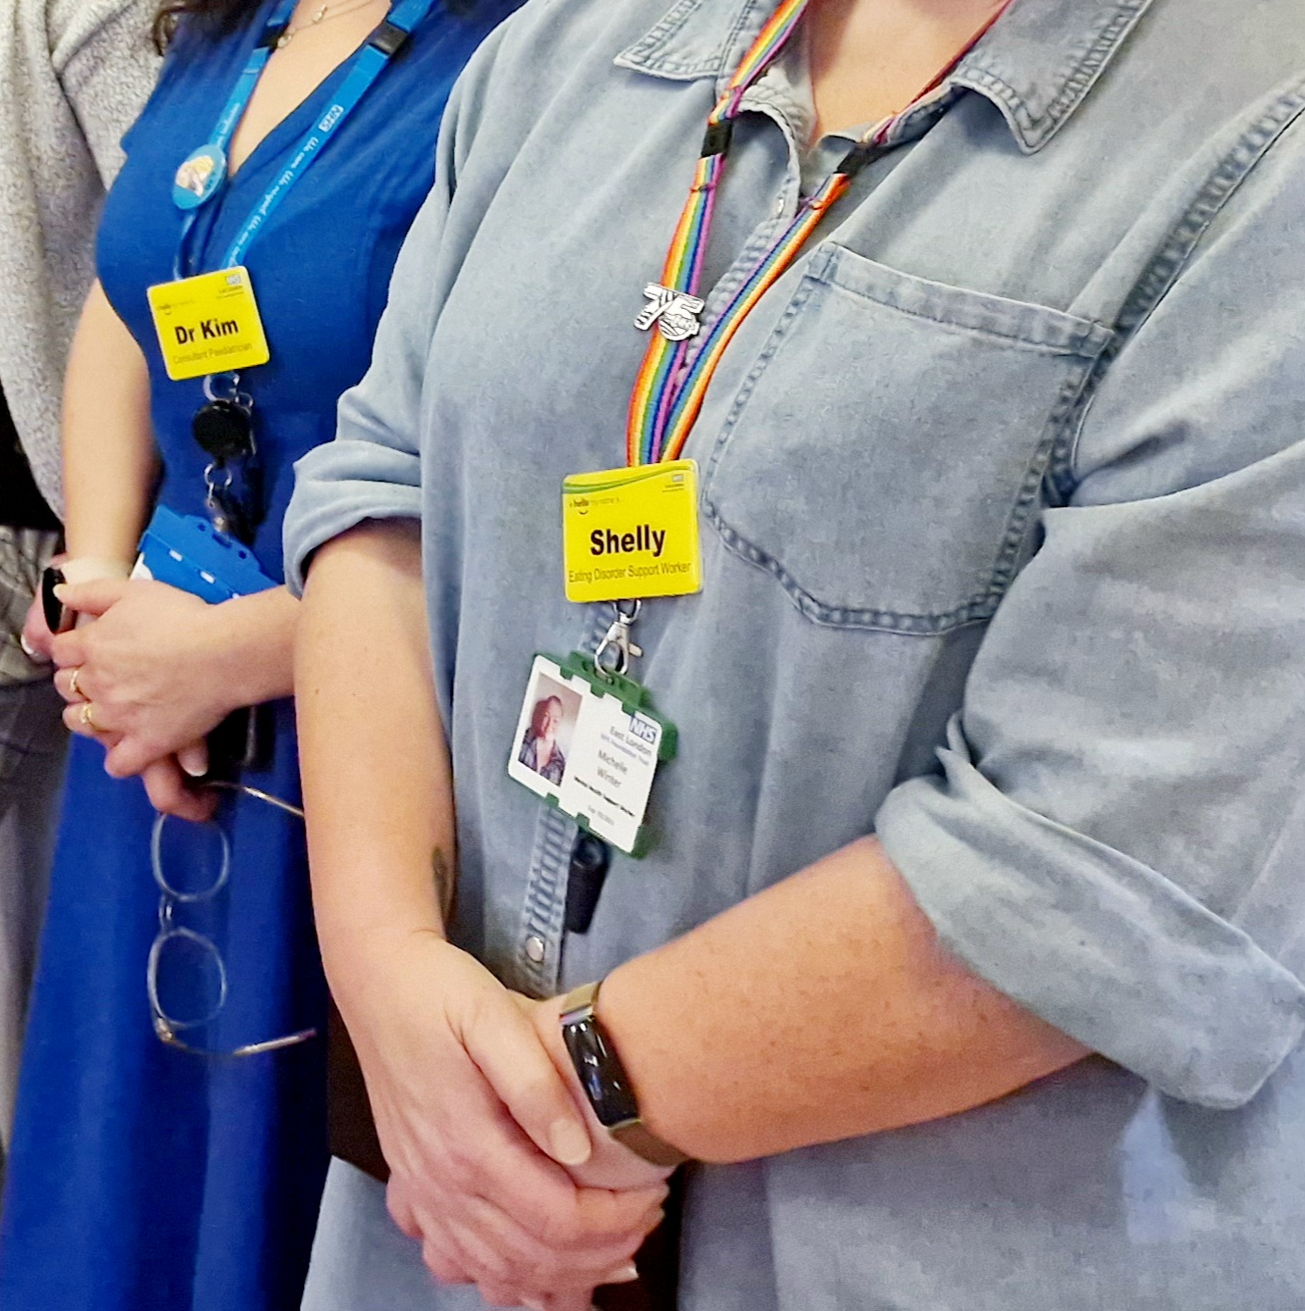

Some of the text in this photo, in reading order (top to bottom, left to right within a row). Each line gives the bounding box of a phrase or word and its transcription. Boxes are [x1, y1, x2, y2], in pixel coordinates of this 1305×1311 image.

[318, 104, 344, 132] NHS
[174, 318, 239, 345] Dr Kim
[590, 524, 666, 557] Shelly
[568, 561, 691, 584] Eating Disorder Support Worker
[609, 726, 652, 756] East London
[630, 717, 656, 744] NHS
[598, 749, 628, 775] Michelle
[597, 767, 622, 789] Winter
